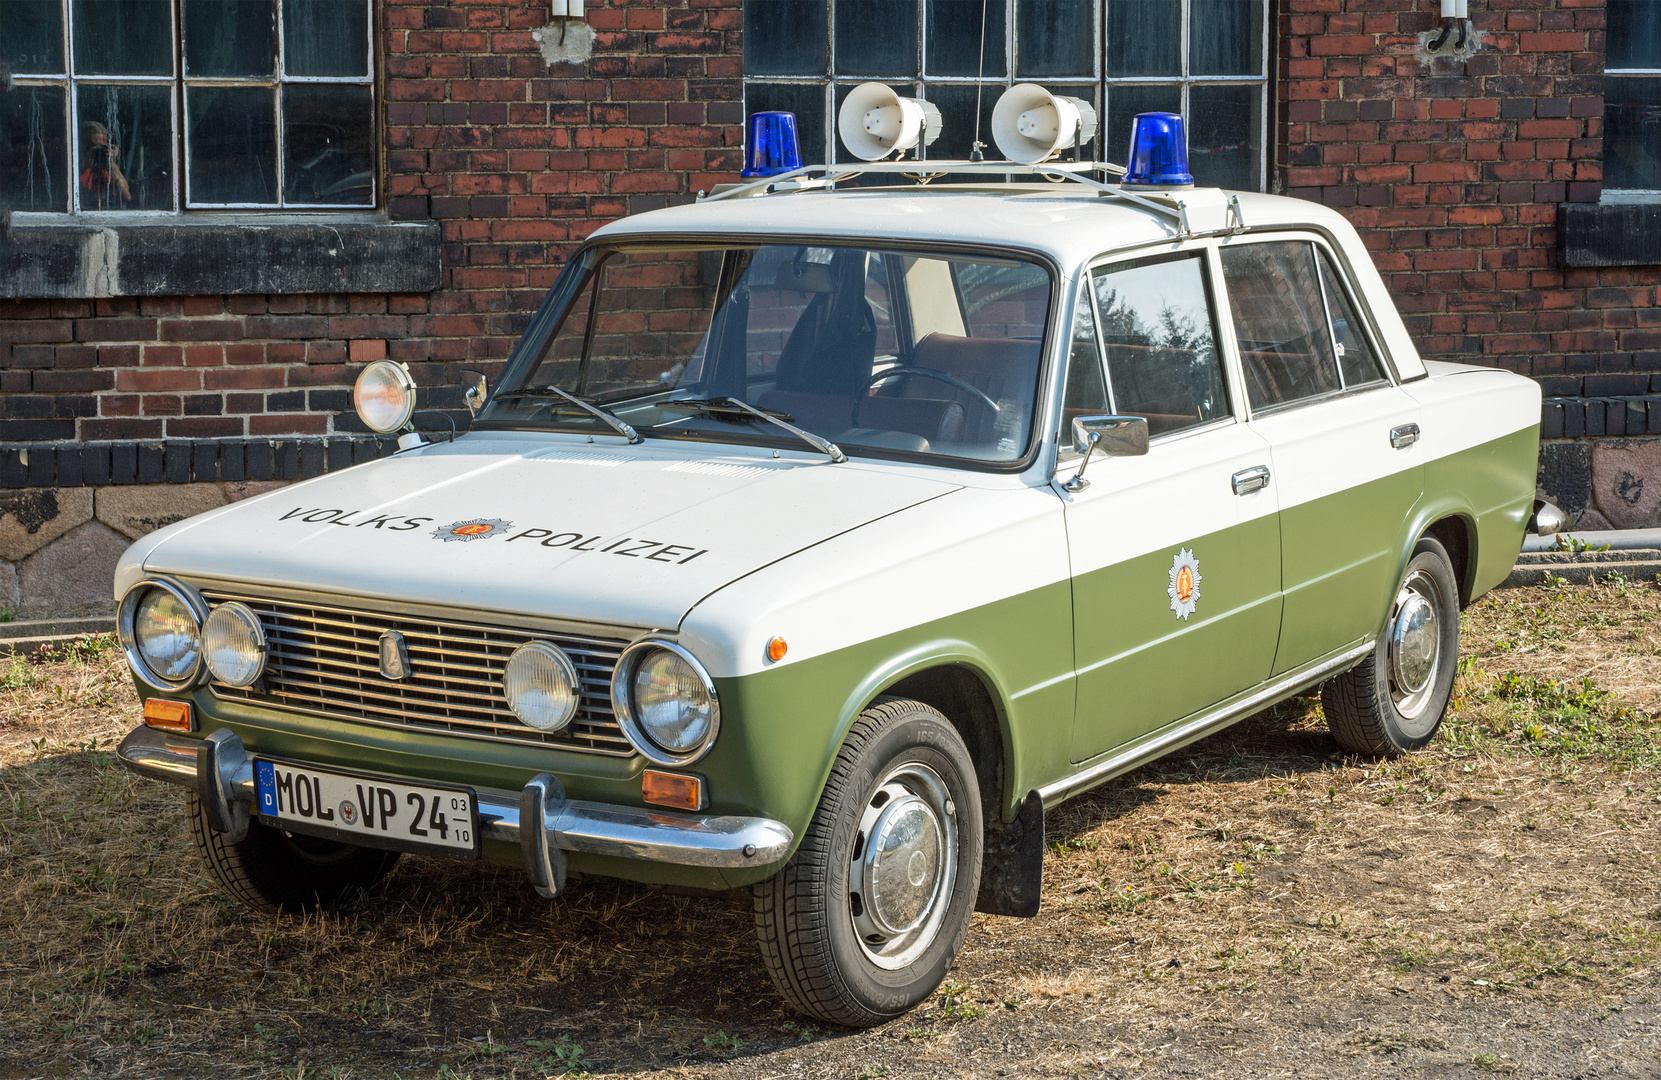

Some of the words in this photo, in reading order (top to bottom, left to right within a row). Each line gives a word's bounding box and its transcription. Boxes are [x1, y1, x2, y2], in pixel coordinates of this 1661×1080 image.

[278, 506, 434, 532] VOLKS
[504, 527, 709, 565] POLIZEI
[265, 793, 272, 806] D
[275, 769, 334, 821] MOL
[356, 783, 397, 831] VP
[406, 791, 448, 840] 24
[451, 797, 467, 811] 03
[454, 828, 470, 843] 10
